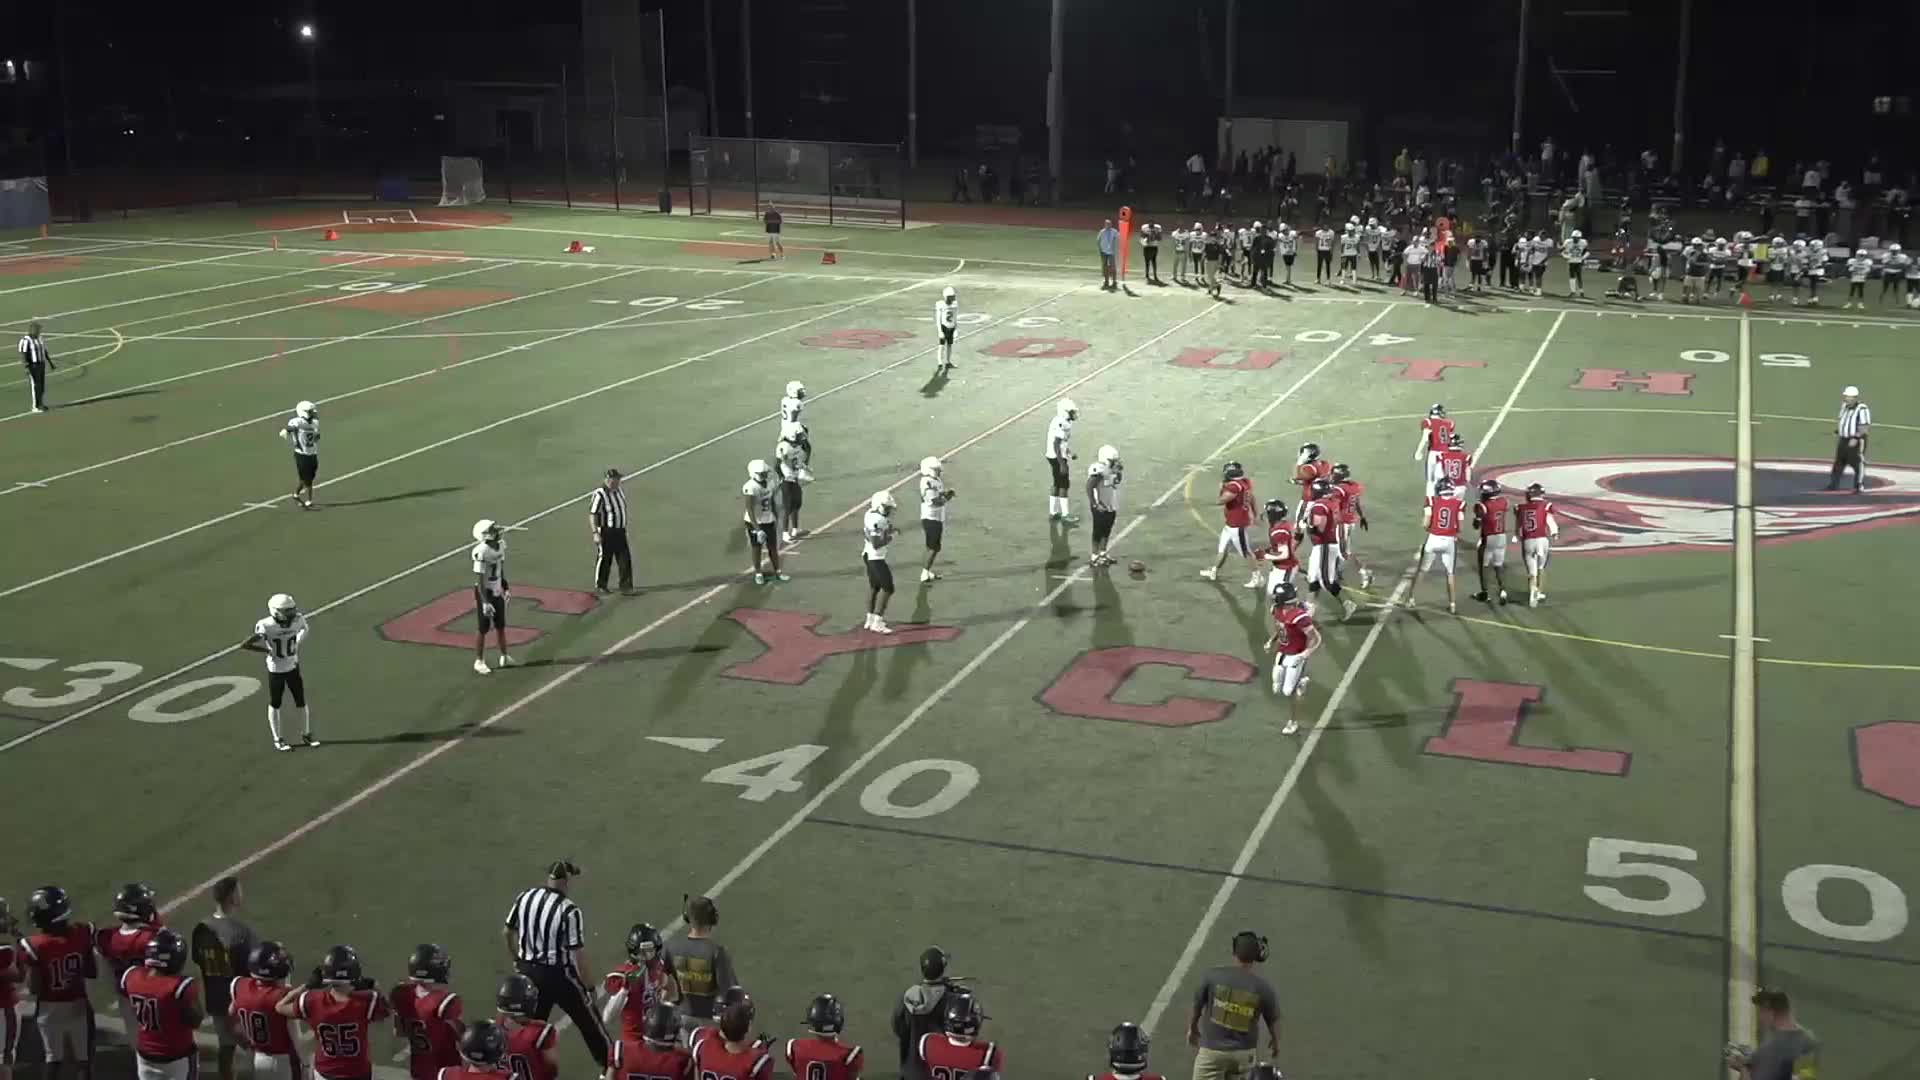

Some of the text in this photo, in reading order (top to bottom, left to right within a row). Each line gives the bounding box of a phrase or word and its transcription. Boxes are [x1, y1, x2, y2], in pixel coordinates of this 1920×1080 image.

[1438, 508, 1451, 529] 9
[1524, 510, 1537, 532] 5
[129, 994, 160, 1031] 71
[238, 1007, 270, 1046] 18
[317, 1022, 360, 1058] 65
